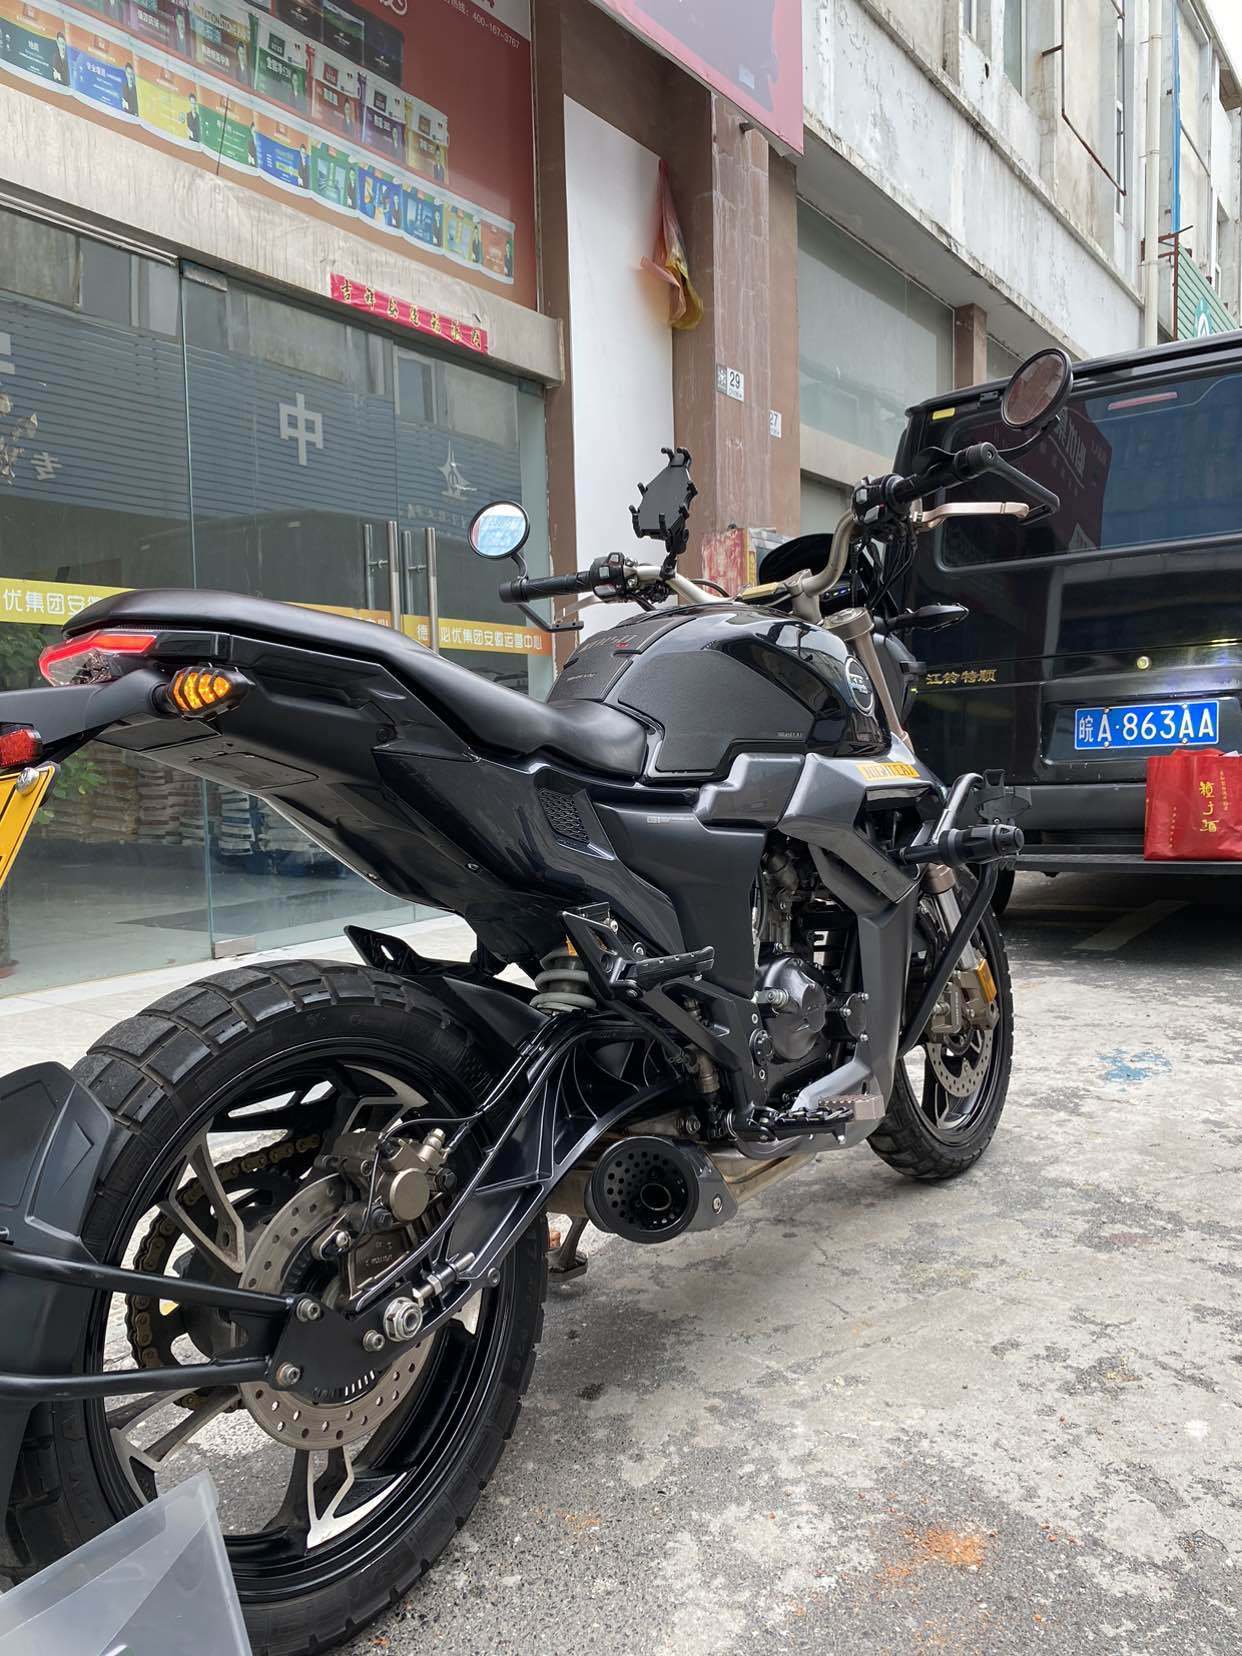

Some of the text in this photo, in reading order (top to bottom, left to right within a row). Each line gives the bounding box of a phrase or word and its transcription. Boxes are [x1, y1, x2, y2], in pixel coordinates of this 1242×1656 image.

[730, 371, 740, 389] 29
[279, 391, 323, 466] 中
[926, 669, 998, 685] 江铃特顺
